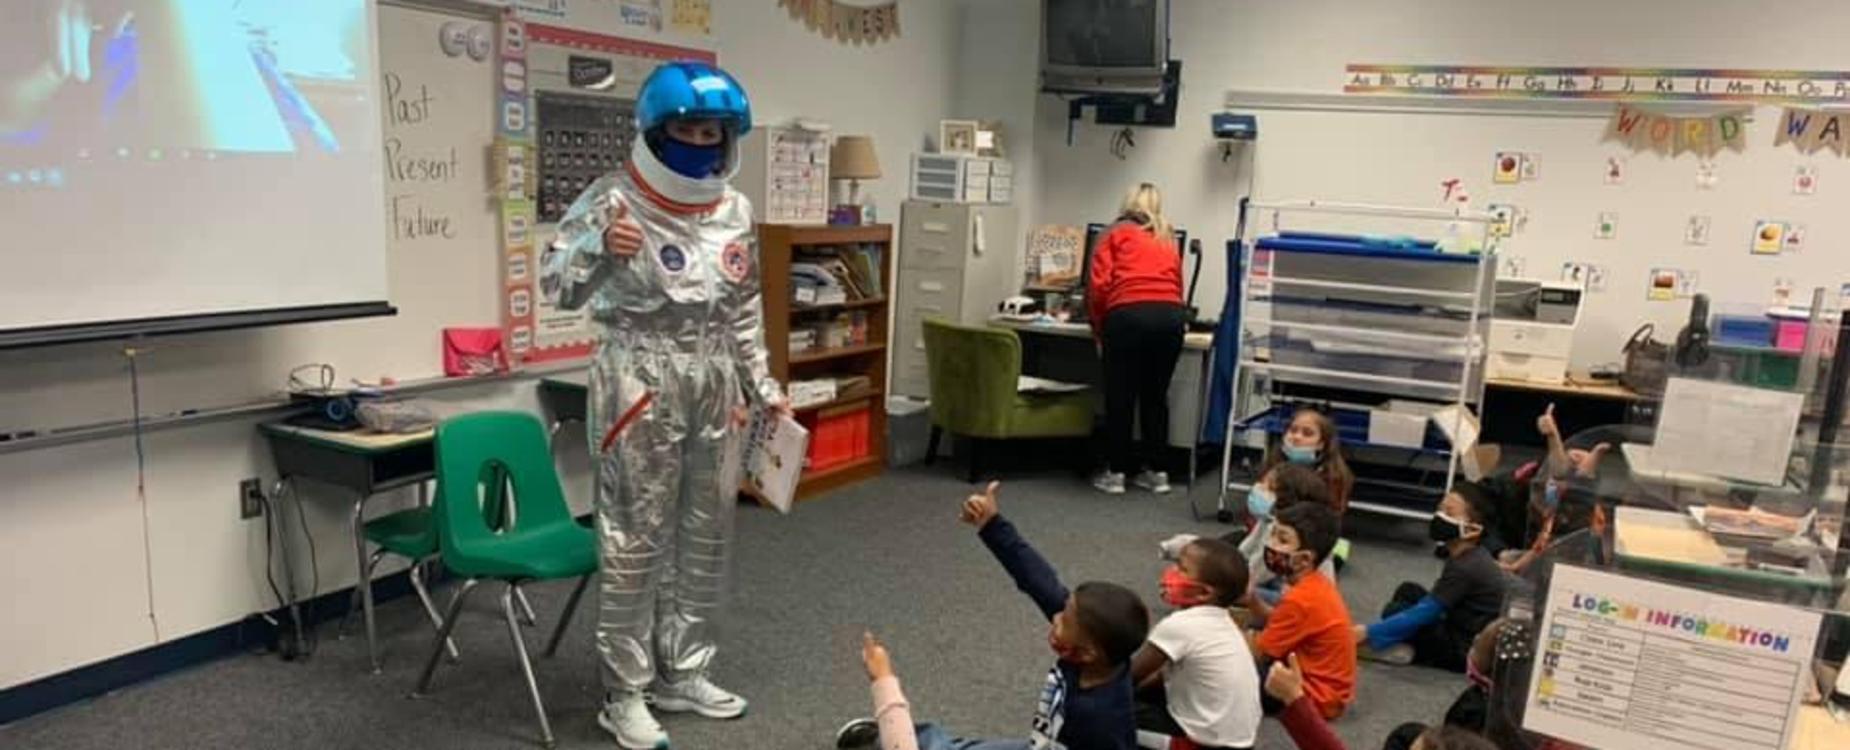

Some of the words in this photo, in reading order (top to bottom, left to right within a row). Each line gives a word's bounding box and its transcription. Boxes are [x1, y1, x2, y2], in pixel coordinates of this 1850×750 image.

[385, 71, 434, 127] Past
[1617, 107, 1739, 142] WORD
[385, 136, 460, 182] Present
[392, 193, 458, 240] Future
[1645, 609, 1790, 653] INFORMATION
